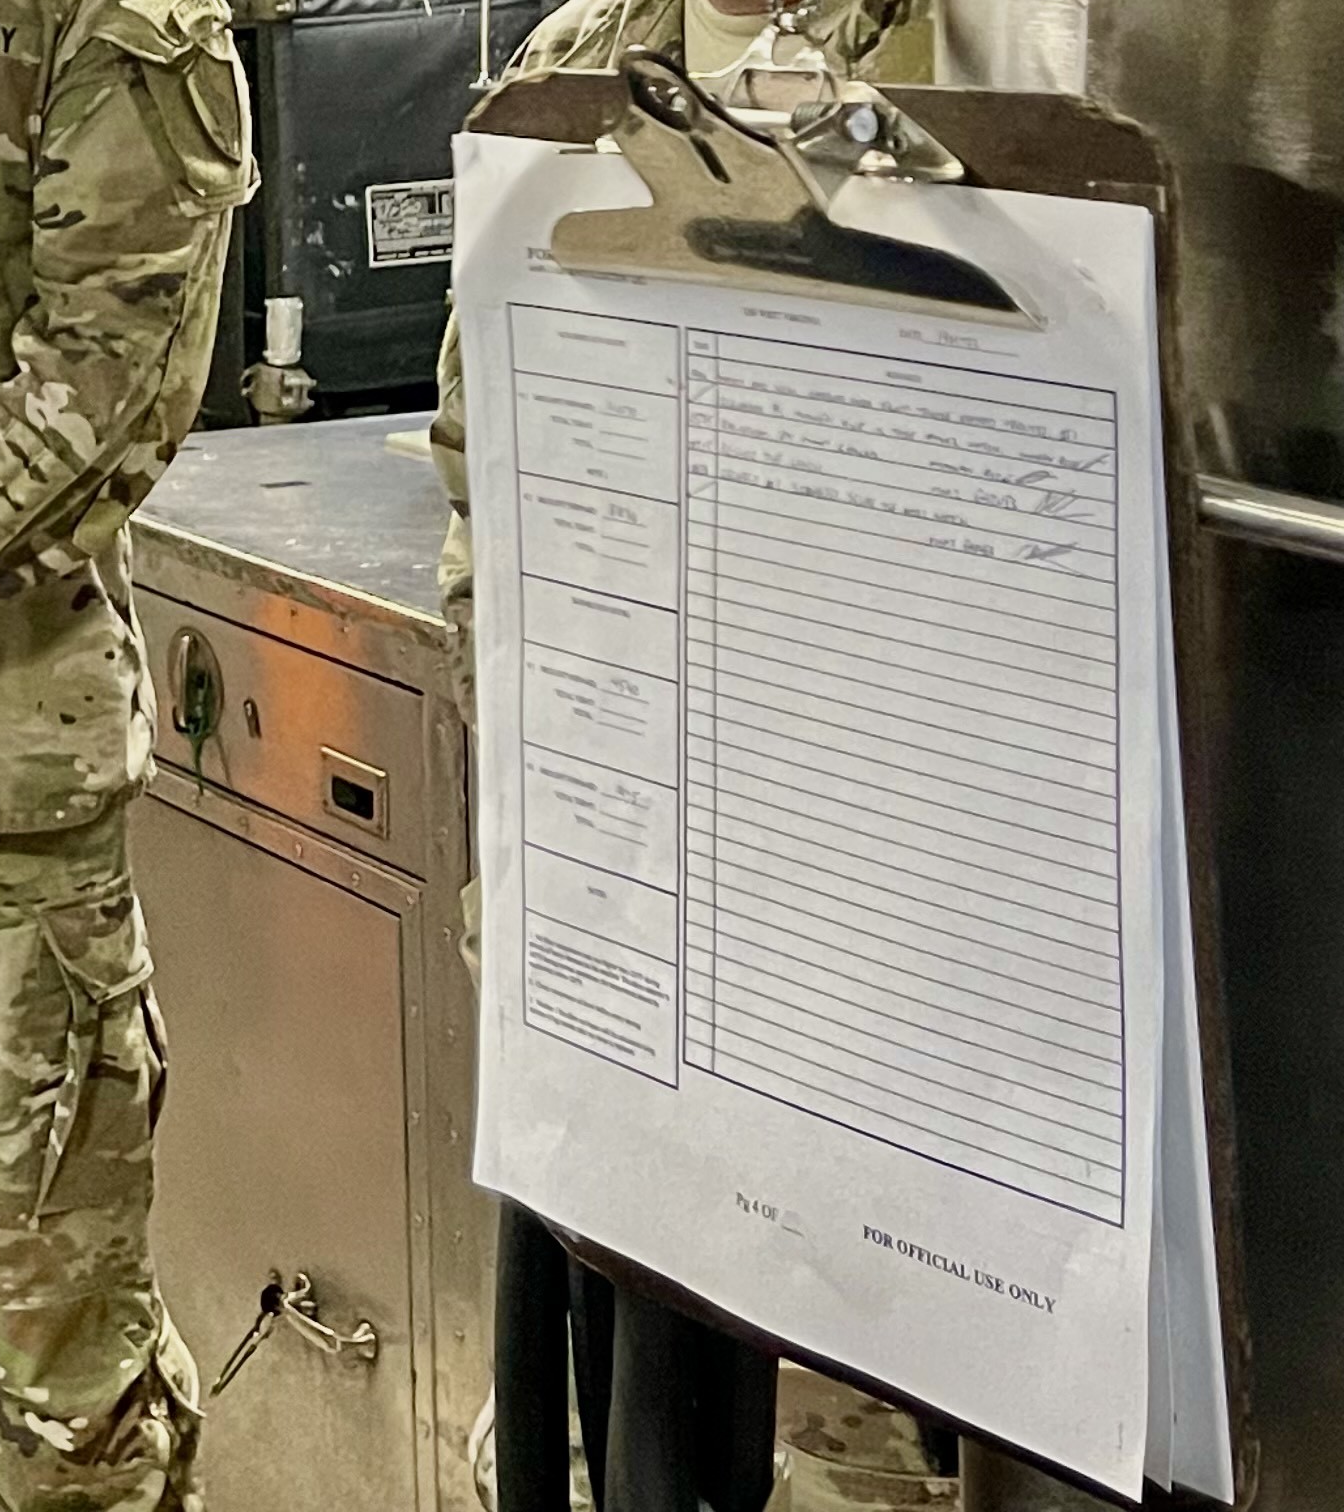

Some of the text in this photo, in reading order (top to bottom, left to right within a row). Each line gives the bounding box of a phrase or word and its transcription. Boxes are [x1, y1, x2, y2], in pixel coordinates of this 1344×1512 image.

[863, 1224, 1056, 1314] FOR OFFICIAL USE ONLY
